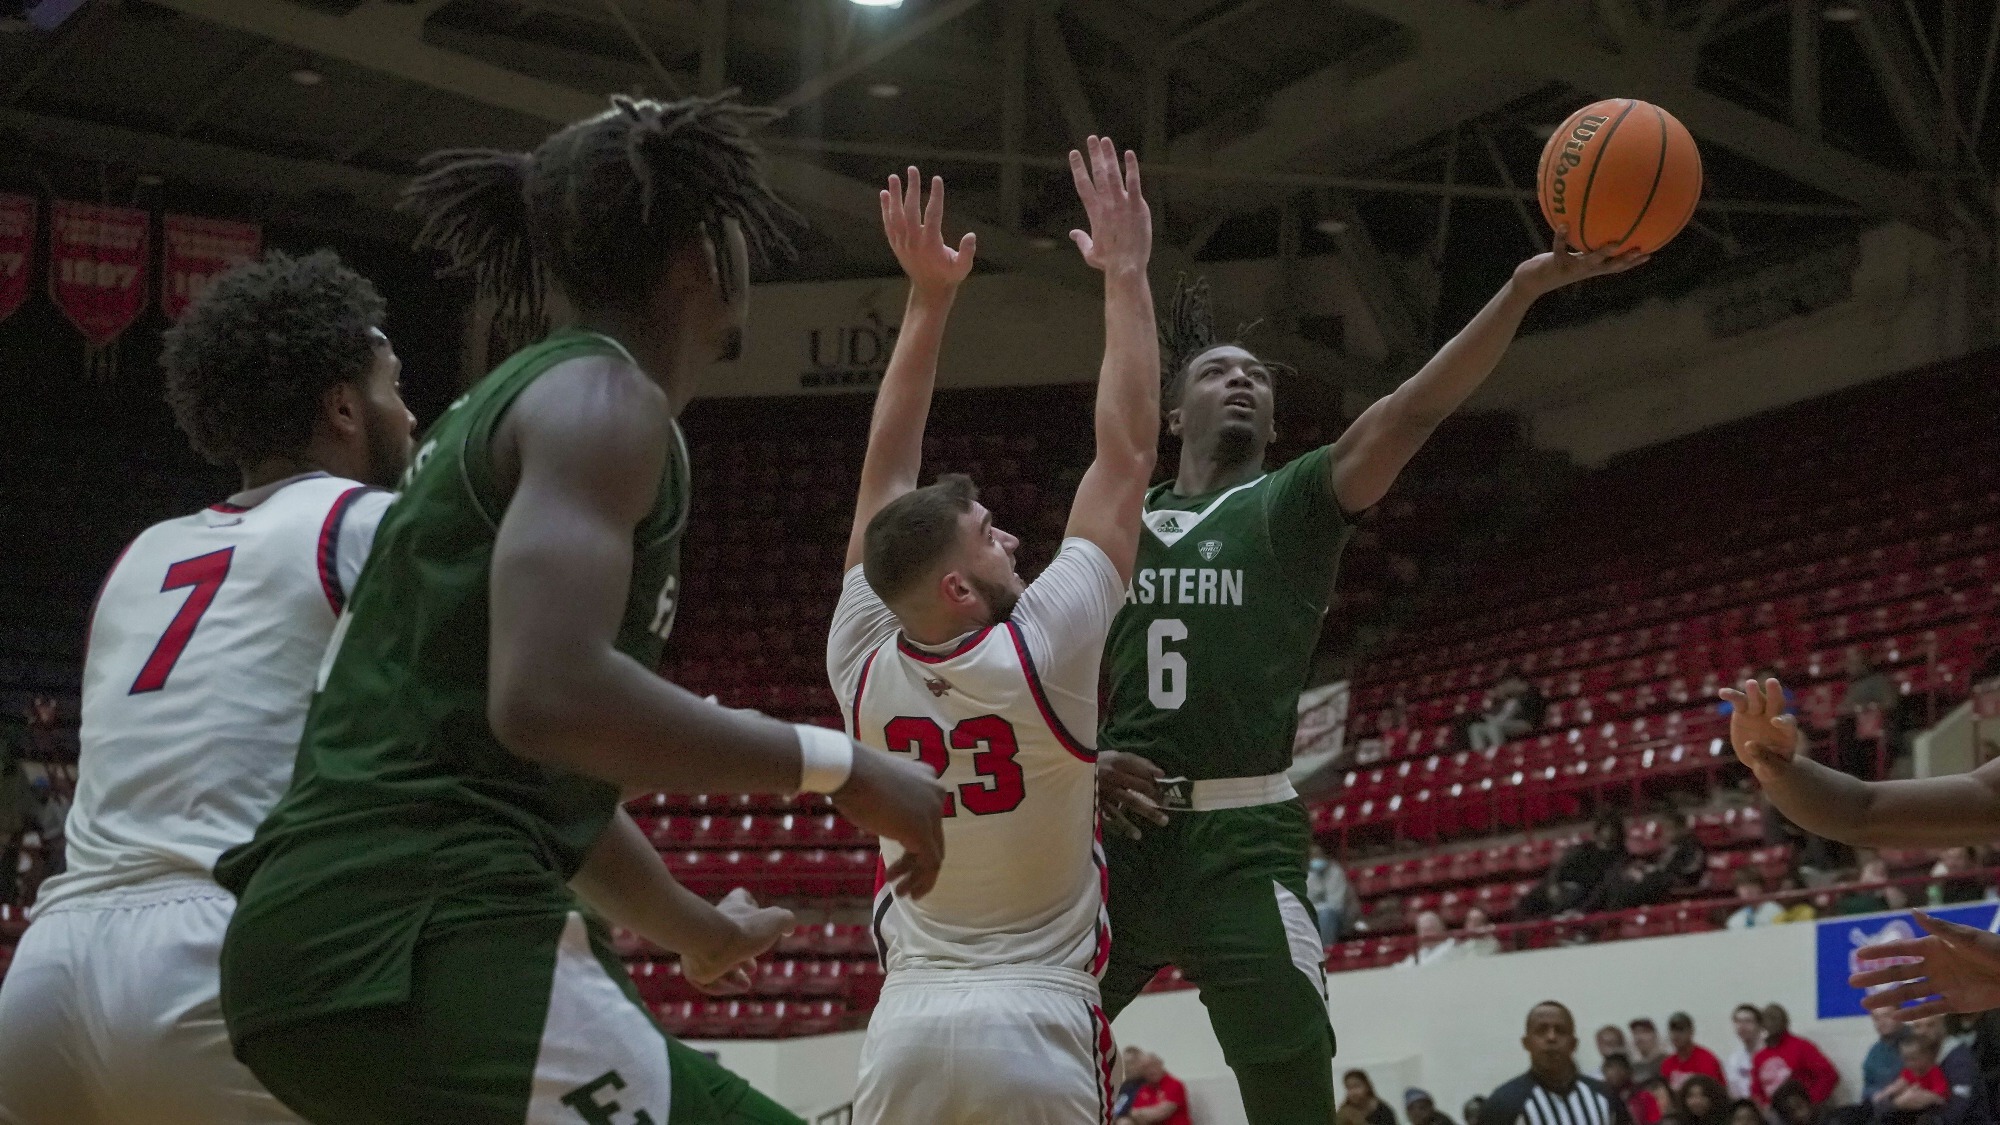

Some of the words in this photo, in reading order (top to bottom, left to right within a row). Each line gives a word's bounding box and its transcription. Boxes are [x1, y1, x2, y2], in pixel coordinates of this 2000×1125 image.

[1553, 113, 1610, 215] Wilson
[128, 546, 235, 695] 7
[1125, 568, 1243, 606] ASTERN
[1147, 618, 1188, 710] 6
